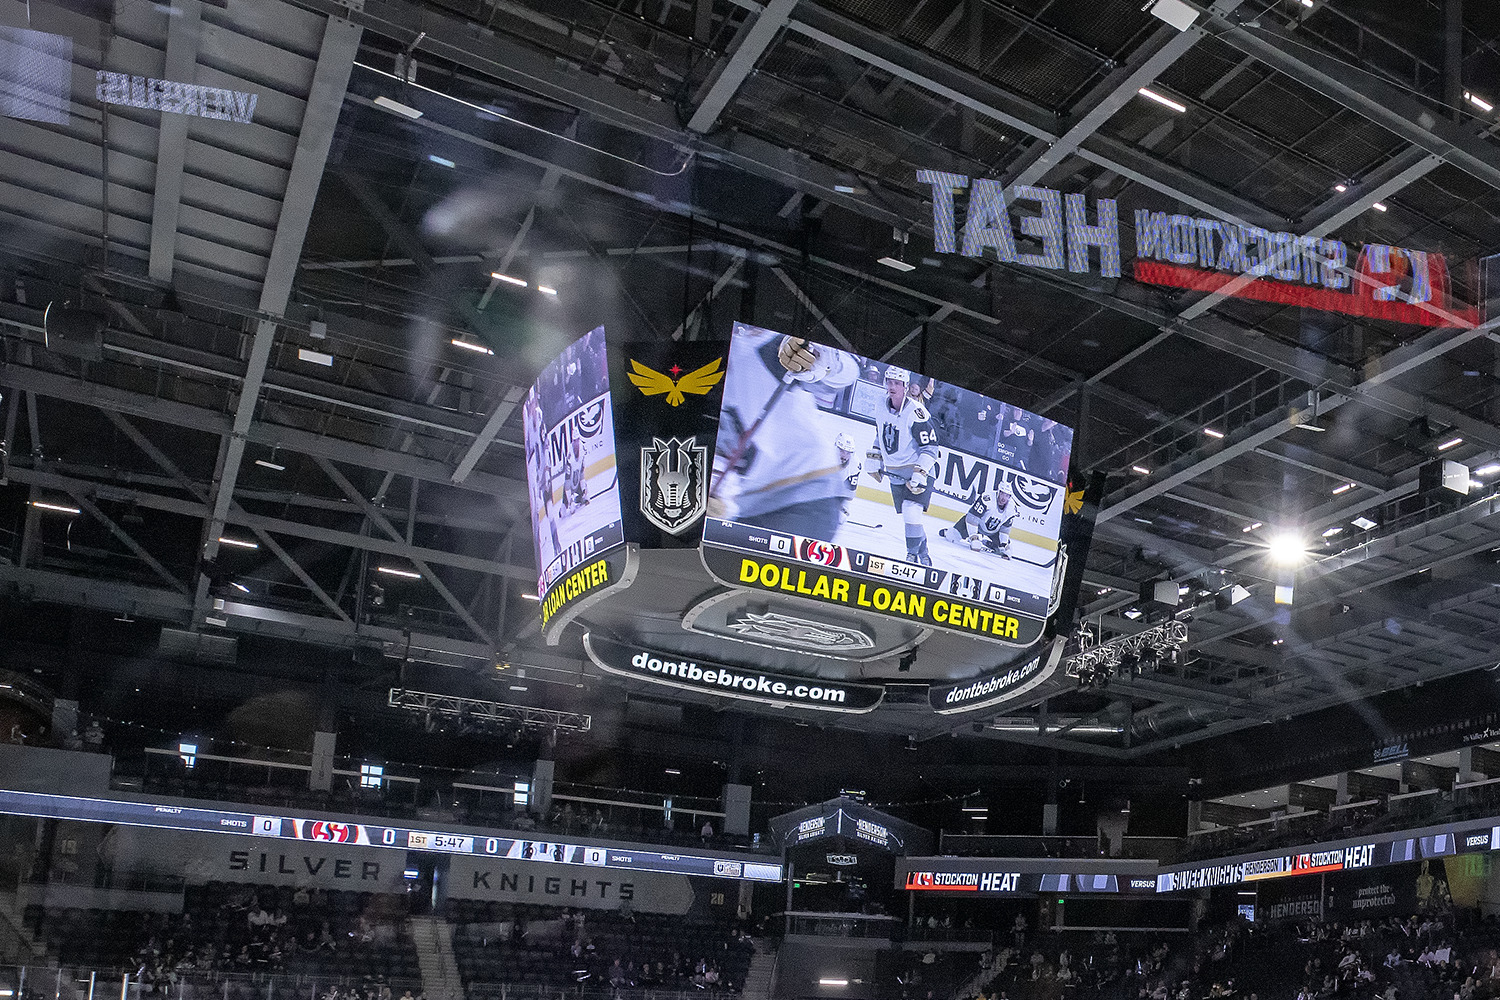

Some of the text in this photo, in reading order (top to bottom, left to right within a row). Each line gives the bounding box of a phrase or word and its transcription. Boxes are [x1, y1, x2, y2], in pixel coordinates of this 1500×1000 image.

[919, 429, 937, 445] 64
[777, 539, 785, 551] 0
[855, 552, 865, 567] 0
[869, 560, 918, 580] 1ST 5:47
[929, 570, 939, 584] 0
[566, 560, 609, 600] CENTER
[739, 558, 1021, 640] DOLLAR LOAN CENTER
[993, 586, 1002, 599] 0
[631, 651, 846, 703] dontbebroke.com
[945, 655, 1040, 704] dontbebroke.com
[220, 819, 272, 832] SHOTS 0
[382, 829, 396, 845] 0
[410, 835, 465, 849] 1ST 5:47
[1466, 834, 1489, 846] VERSUS
[485, 838, 499, 854] 0
[591, 851, 600, 863] 0
[1310, 849, 1344, 868] STOCKTON
[1344, 843, 1376, 869] HEAT
[229, 850, 381, 881] SILVER
[472, 870, 635, 901] KNIGHTS
[934, 871, 1021, 892] STOCKTON HEAT
[1130, 879, 1156, 889] VERSUS
[1270, 899, 1321, 919] HENDERSO
